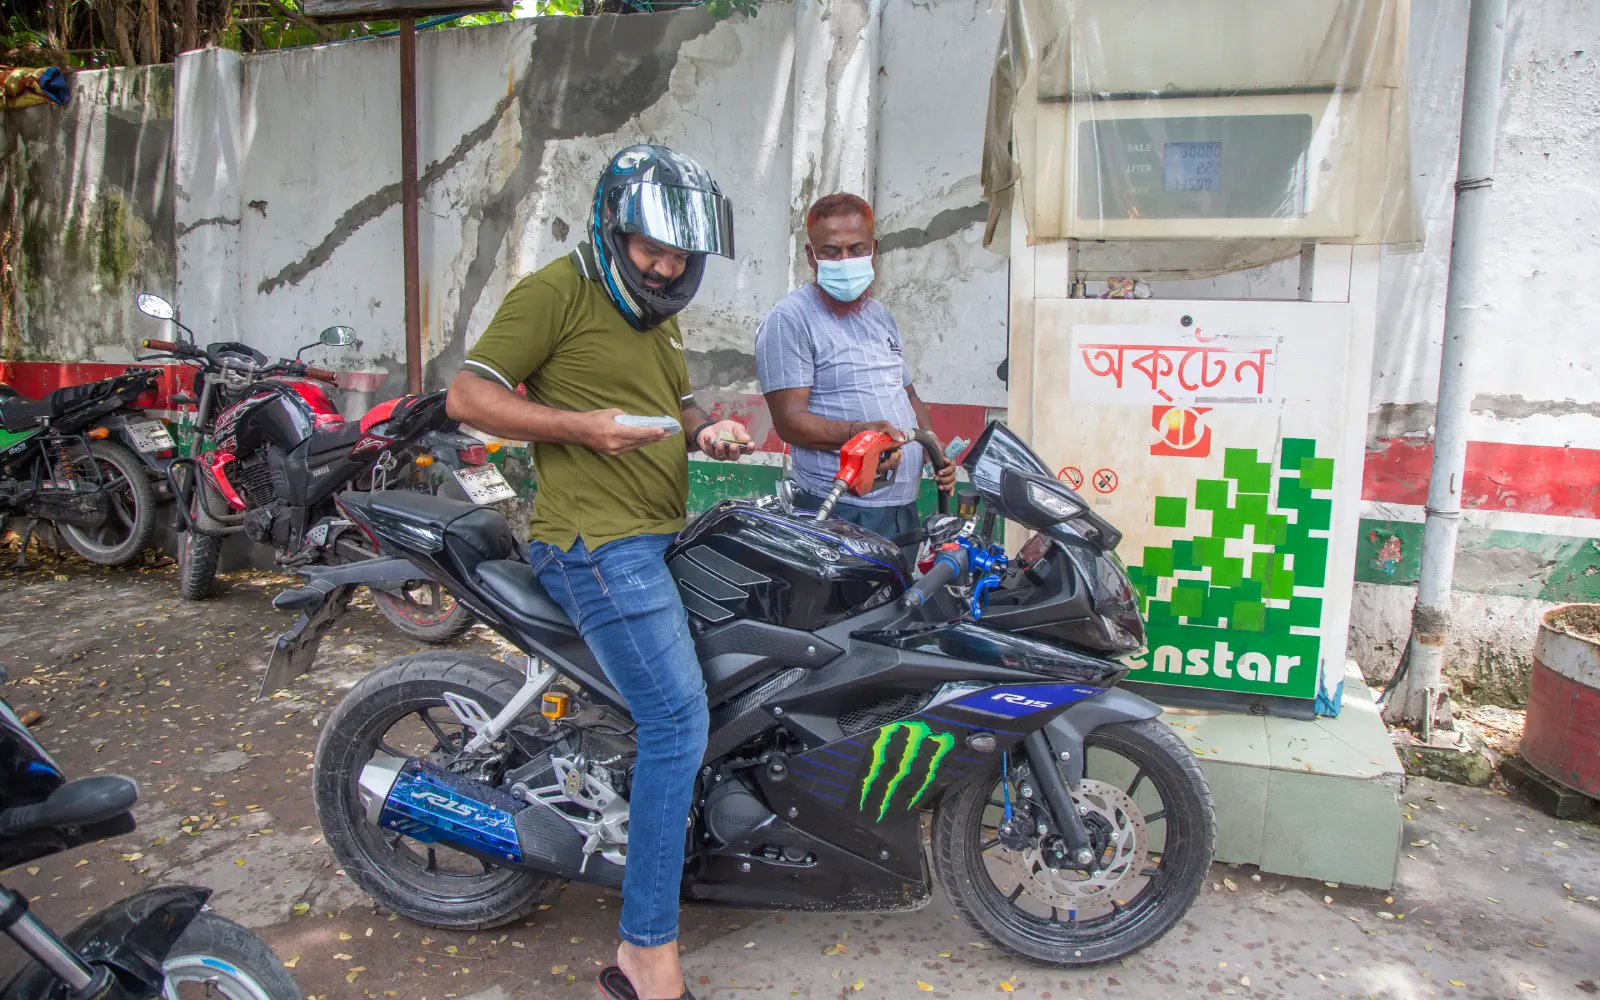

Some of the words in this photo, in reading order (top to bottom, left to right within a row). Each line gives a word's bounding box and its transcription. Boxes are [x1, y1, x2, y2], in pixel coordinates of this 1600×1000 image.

[1127, 143, 1152, 152] SALE
[1127, 164, 1152, 173] LITER
[991, 693, 1053, 708] R15
[411, 791, 479, 816] R15
